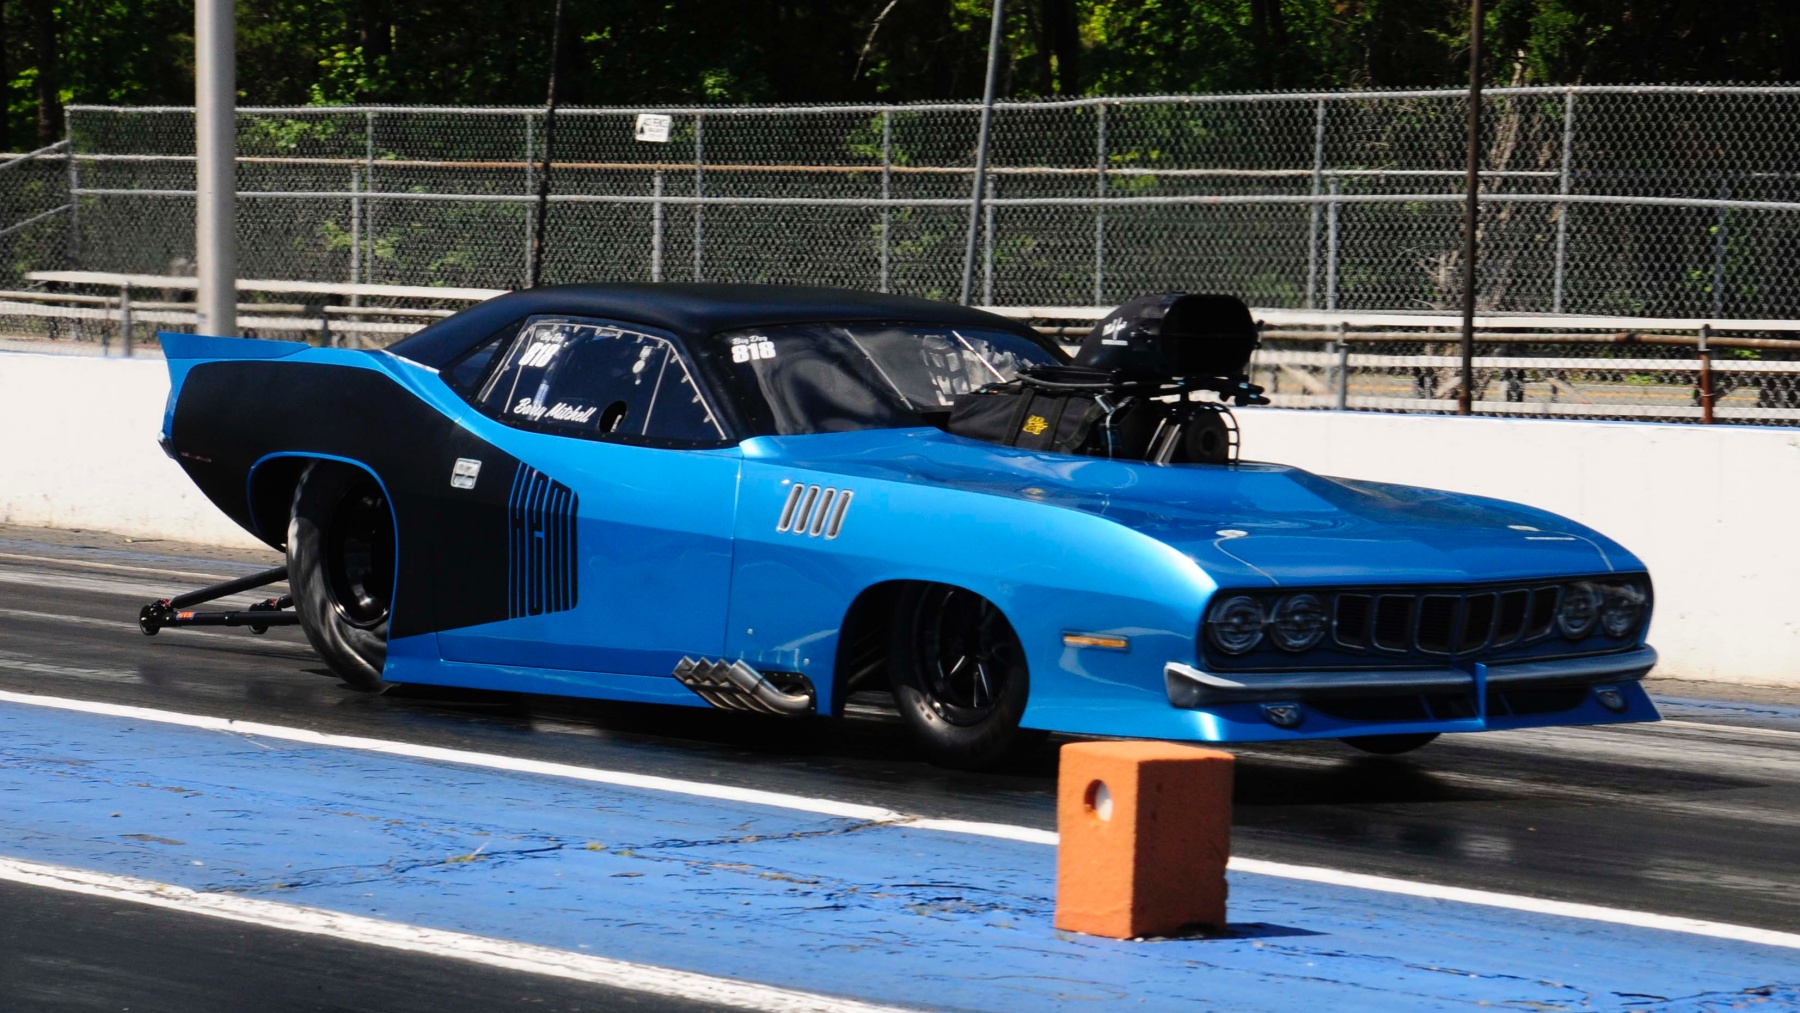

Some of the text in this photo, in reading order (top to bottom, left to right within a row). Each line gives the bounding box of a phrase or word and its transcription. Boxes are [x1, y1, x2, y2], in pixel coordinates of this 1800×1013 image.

[517, 341, 561, 368] 818
[731, 341, 776, 363] 818
[544, 402, 598, 423] Mitchell
